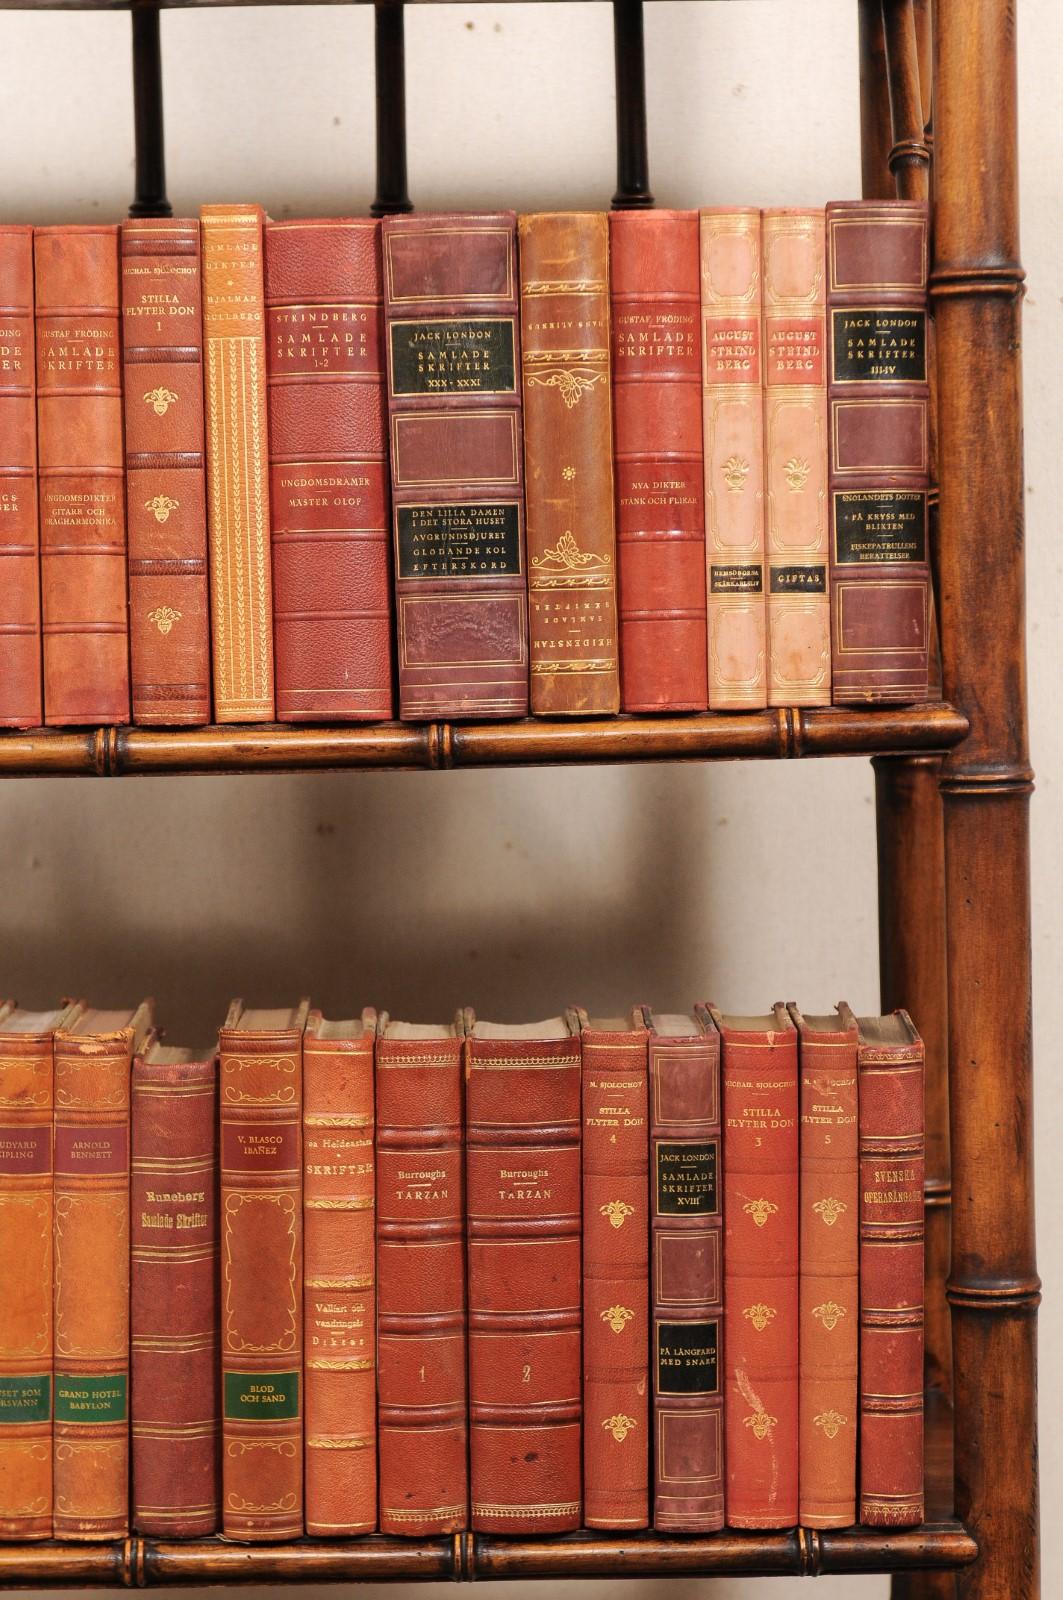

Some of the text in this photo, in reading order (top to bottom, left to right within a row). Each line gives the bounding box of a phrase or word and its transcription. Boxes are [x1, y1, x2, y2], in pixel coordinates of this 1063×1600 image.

[141, 295, 179, 303] STILLA
[127, 307, 195, 316] FLYTER DON
[277, 313, 367, 322] STRINDBERG
[618, 314, 694, 324] GUSTAF FRÖDING
[845, 320, 870, 328] JACK
[277, 333, 366, 343] SAMLADE
[415, 331, 491, 341] JACK LONDON
[618, 332, 694, 342] SAMLADE
[713, 331, 754, 340] AUGUST
[772, 331, 816, 340] AUGUST
[848, 339, 915, 347] SAMLADE
[277, 347, 367, 358] SKRIFTER
[418, 350, 489, 360] SAMLADE
[618, 346, 694, 356] SKRIFTER
[848, 350, 915, 359] SKRIFTER
[314, 359, 328, 367] 1-2
[418, 362, 490, 373] SKRIFTER
[717, 360, 750, 370] BERG
[776, 360, 813, 370] BERG
[281, 477, 370, 487] UNGDOMSDRAMER
[334, 497, 361, 506] OLOF
[52, 508, 82, 516] GITARR
[442, 518, 472, 526] STORA
[476, 517, 506, 525] HUSET
[852, 513, 863, 521] PÅ
[413, 532, 506, 541] AVGRUNDSDJURET
[778, 575, 819, 583] GIFTAS
[544, 615, 603, 624] SAMLADE
[743, 1109, 781, 1117] STILLA
[586, 1118, 619, 1126] FLYTER
[727, 1119, 794, 1128] FLYTER DON
[610, 1134, 616, 1143] 4
[755, 1137, 762, 1146] 3
[73, 1141, 110, 1149] ARNOLD
[71, 1151, 112, 1159] BENNETT
[660, 1153, 715, 1163] JACK LONDON
[398, 1170, 446, 1180] Burroughs
[500, 1169, 549, 1179] Burroughs
[662, 1172, 713, 1181] SAMLADE
[662, 1184, 713, 1193] SKRIFTER
[146, 1191, 204, 1202] Runeberg
[396, 1190, 448, 1200] TARZAN
[498, 1190, 551, 1200] TARZAN
[660, 1347, 670, 1355] PÅ
[420, 1365, 426, 1382] 1
[522, 1364, 531, 1382] 2
[59, 1390, 122, 1399] GRAND HOTEL
